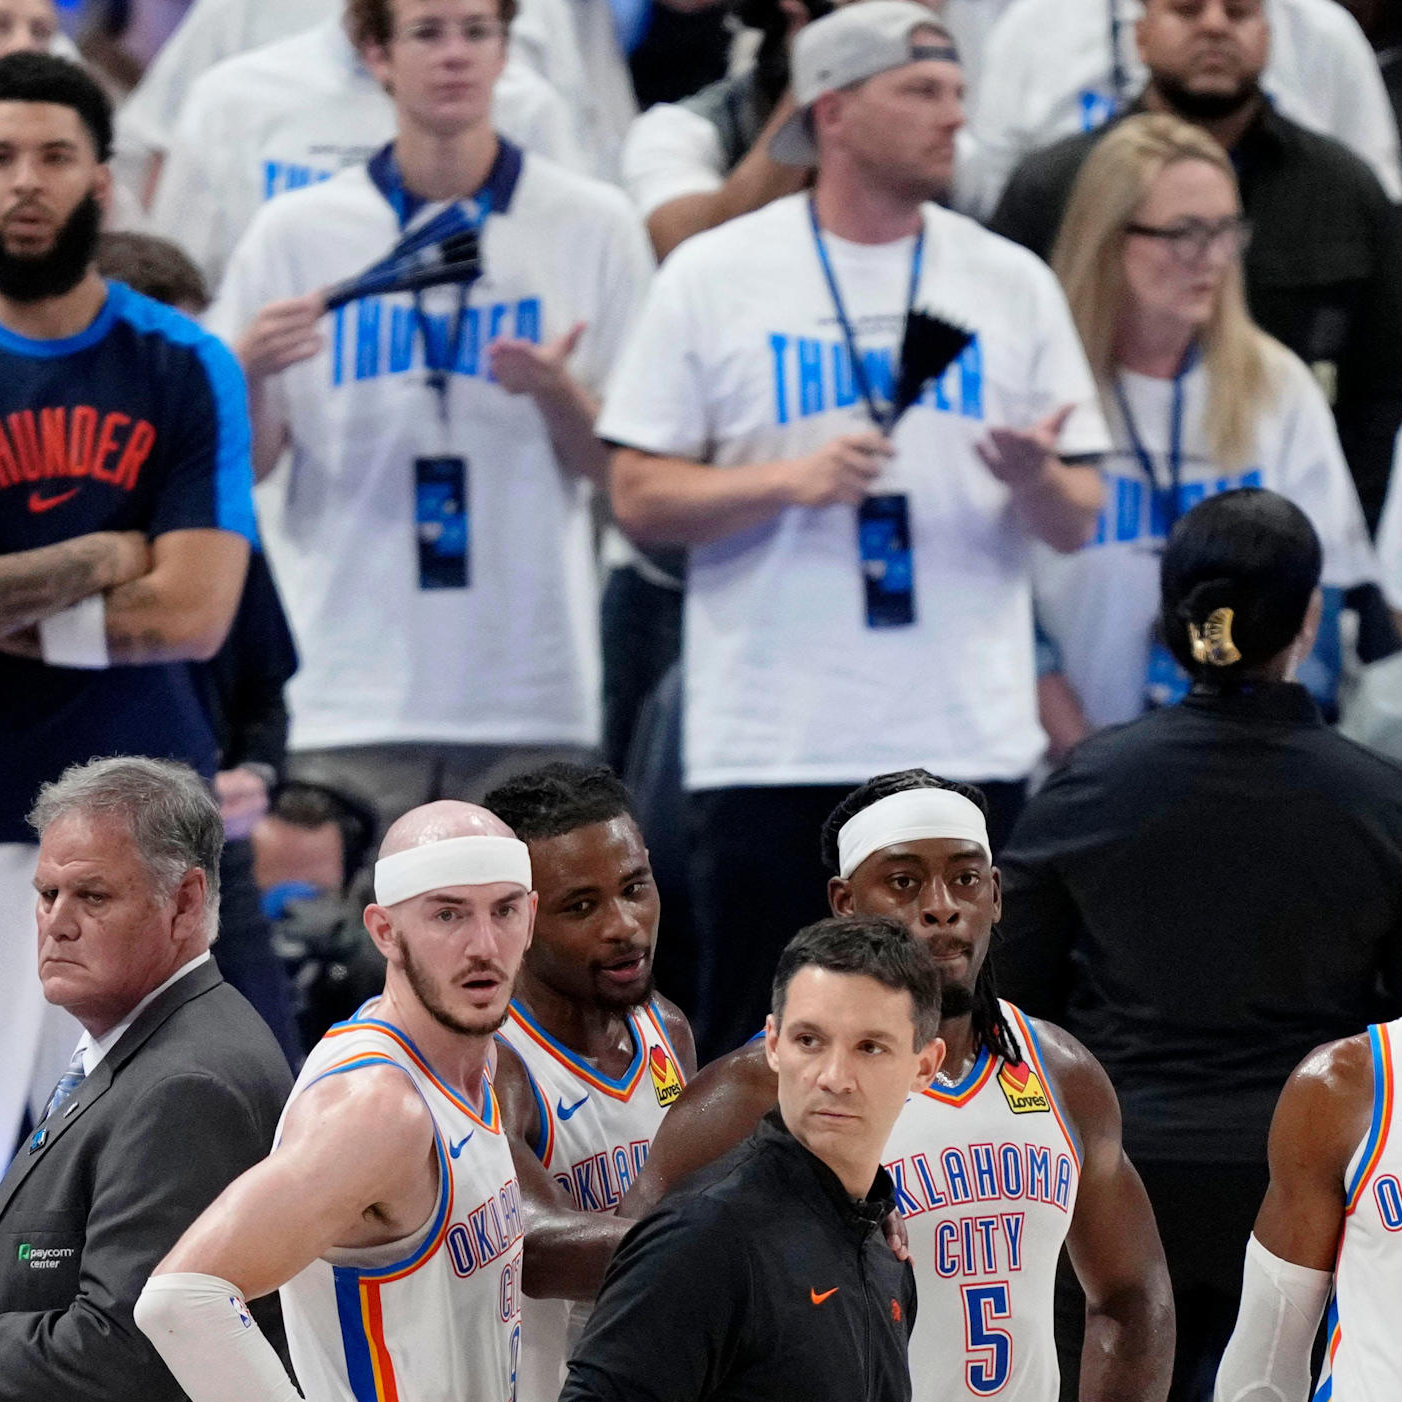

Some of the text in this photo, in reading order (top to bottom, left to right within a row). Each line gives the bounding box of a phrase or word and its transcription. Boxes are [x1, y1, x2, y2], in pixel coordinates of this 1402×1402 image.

[883, 1142, 1073, 1220] KLAHOMA
[30, 1248, 72, 1260] paycom
[30, 1260, 61, 1269] center
[934, 1211, 1026, 1279] CITY
[959, 1279, 1013, 1397] 5
